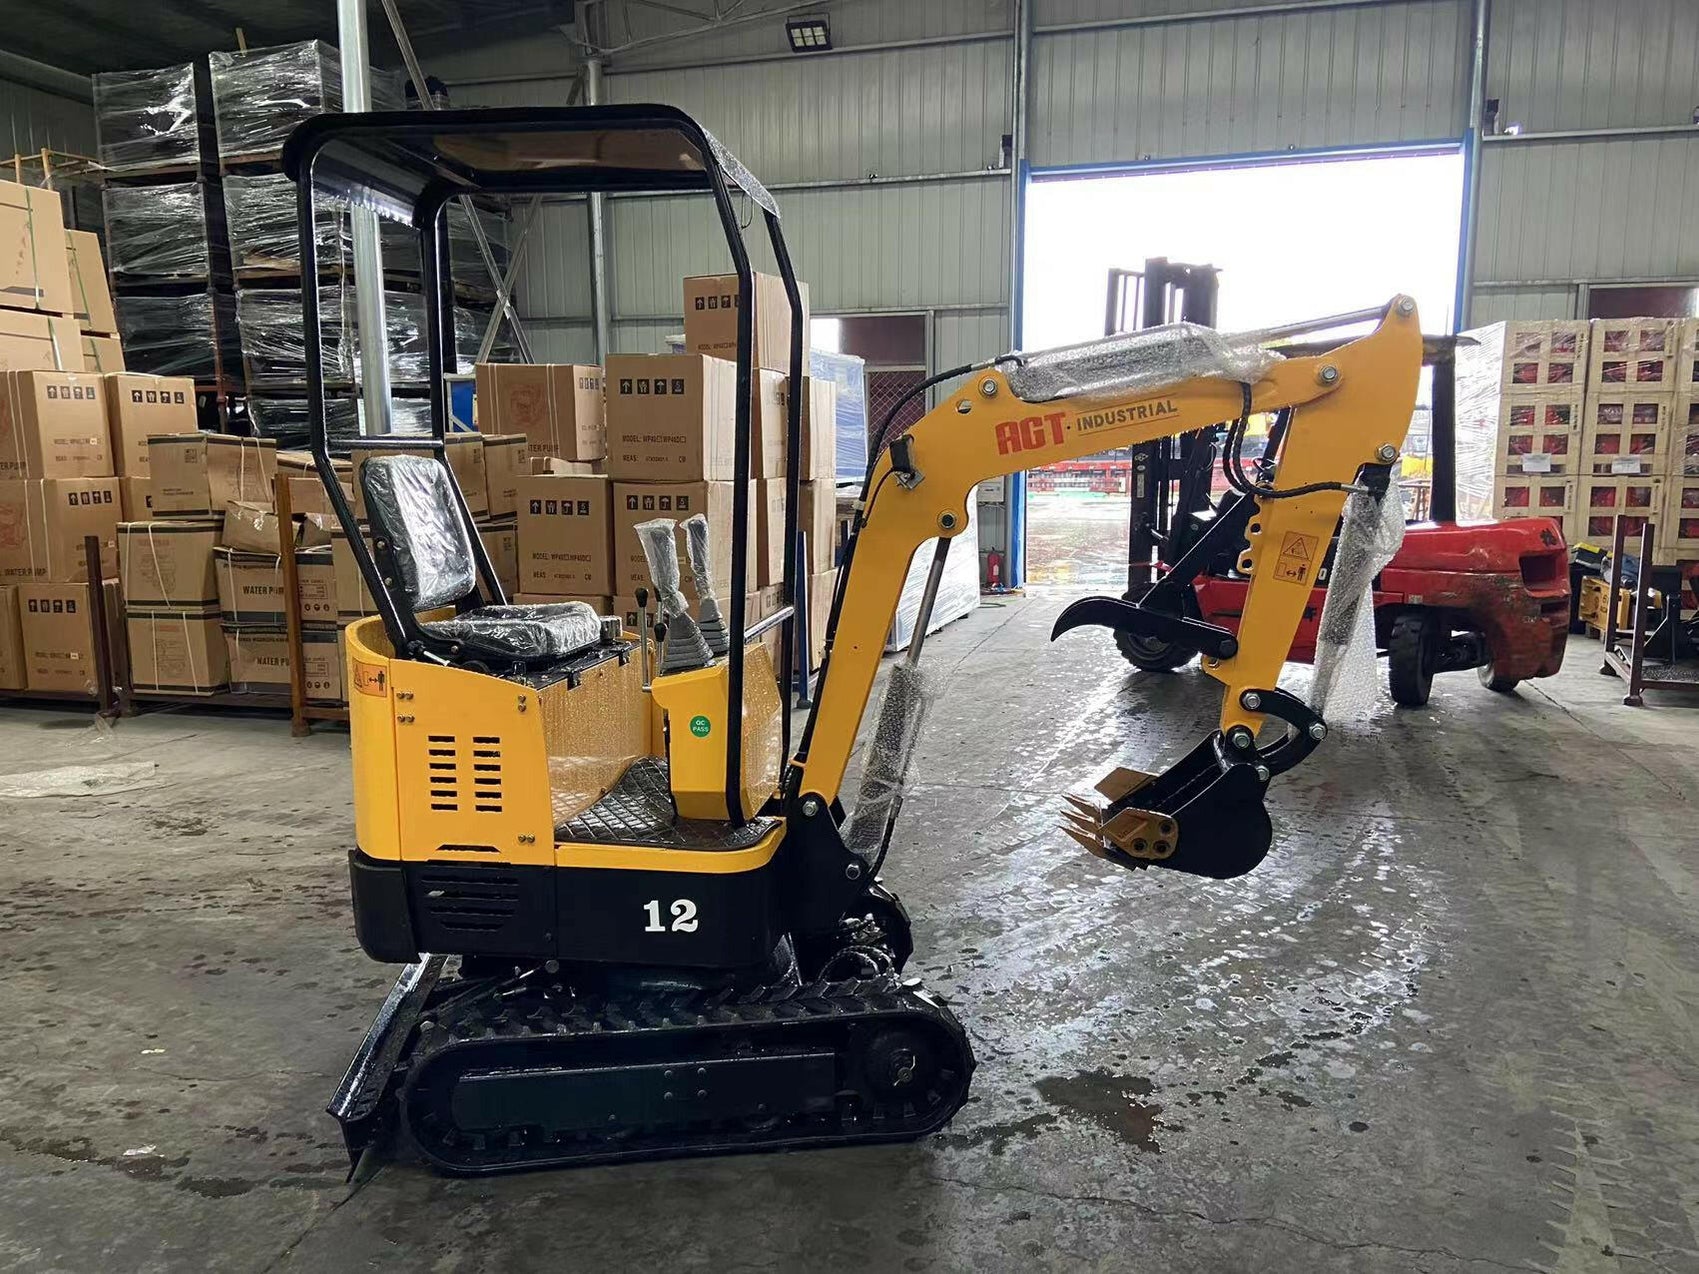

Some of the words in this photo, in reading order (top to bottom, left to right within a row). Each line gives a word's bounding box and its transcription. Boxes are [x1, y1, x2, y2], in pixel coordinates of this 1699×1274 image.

[995, 411, 1066, 456] AGT
[1076, 400, 1178, 431] INDUSTRIAL
[243, 585, 267, 596] WATER
[256, 657, 280, 666] WATER
[643, 898, 699, 933] 12
